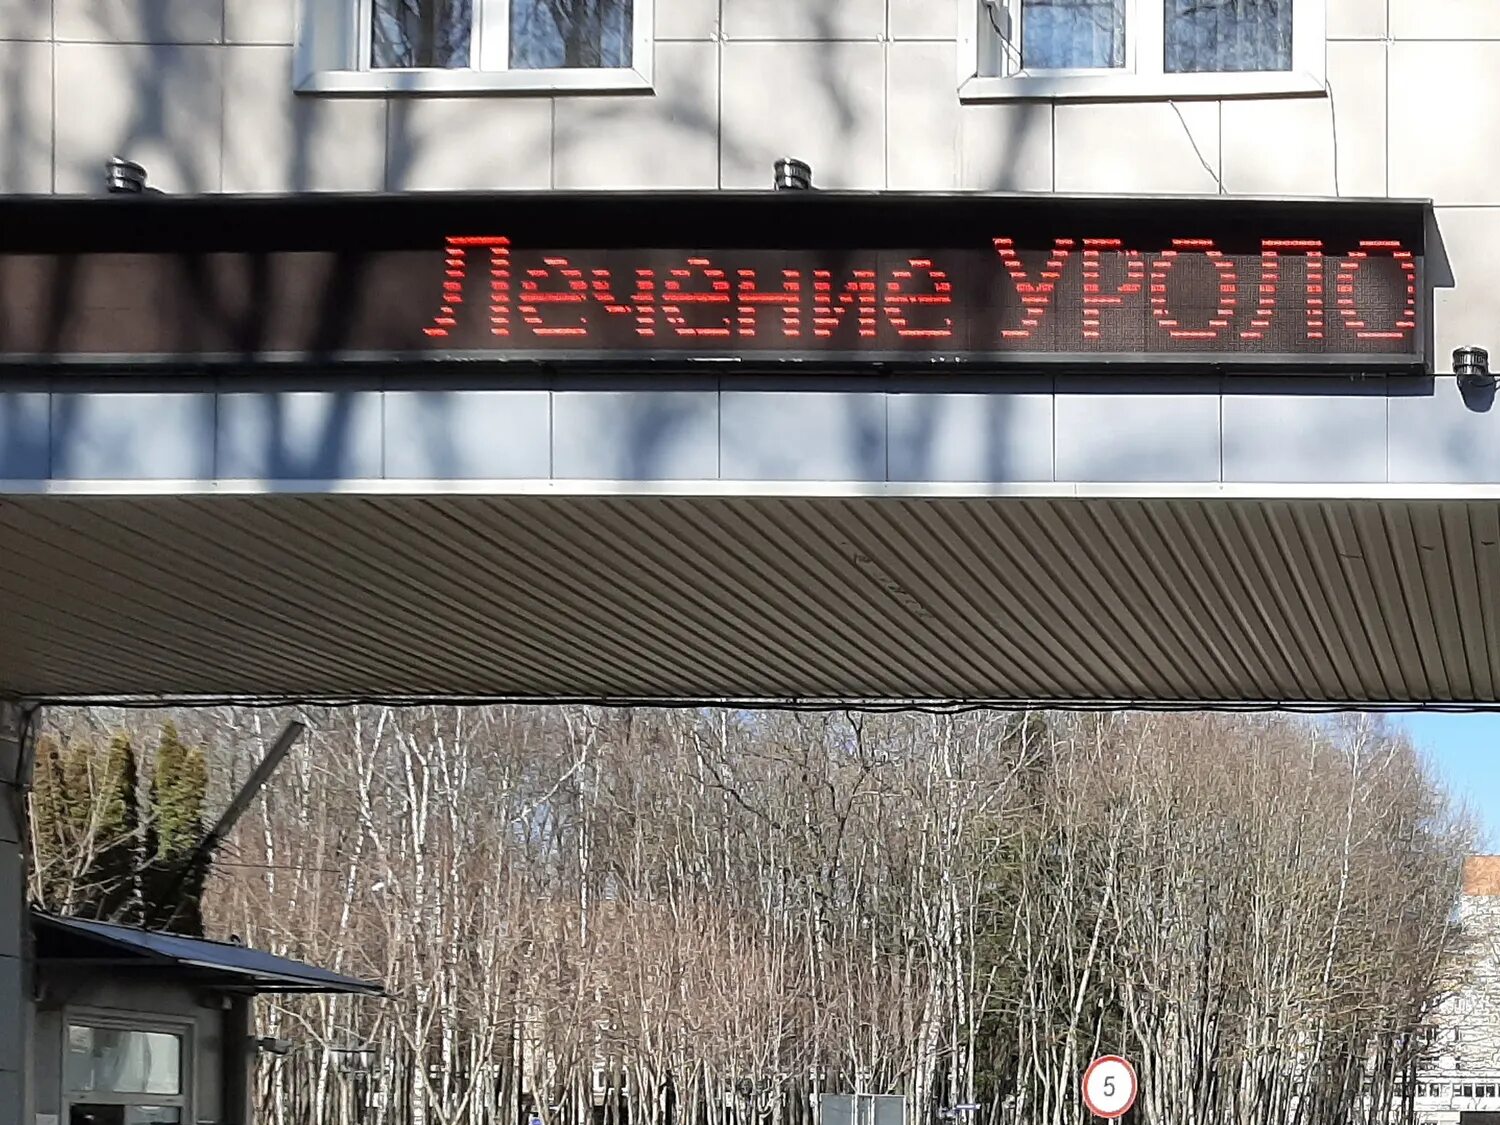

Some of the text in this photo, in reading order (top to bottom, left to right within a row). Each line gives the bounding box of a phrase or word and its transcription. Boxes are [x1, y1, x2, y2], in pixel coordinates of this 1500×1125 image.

[422, 236, 1416, 339] Лечение УРОЛО
[1103, 1075, 1116, 1097] 5
